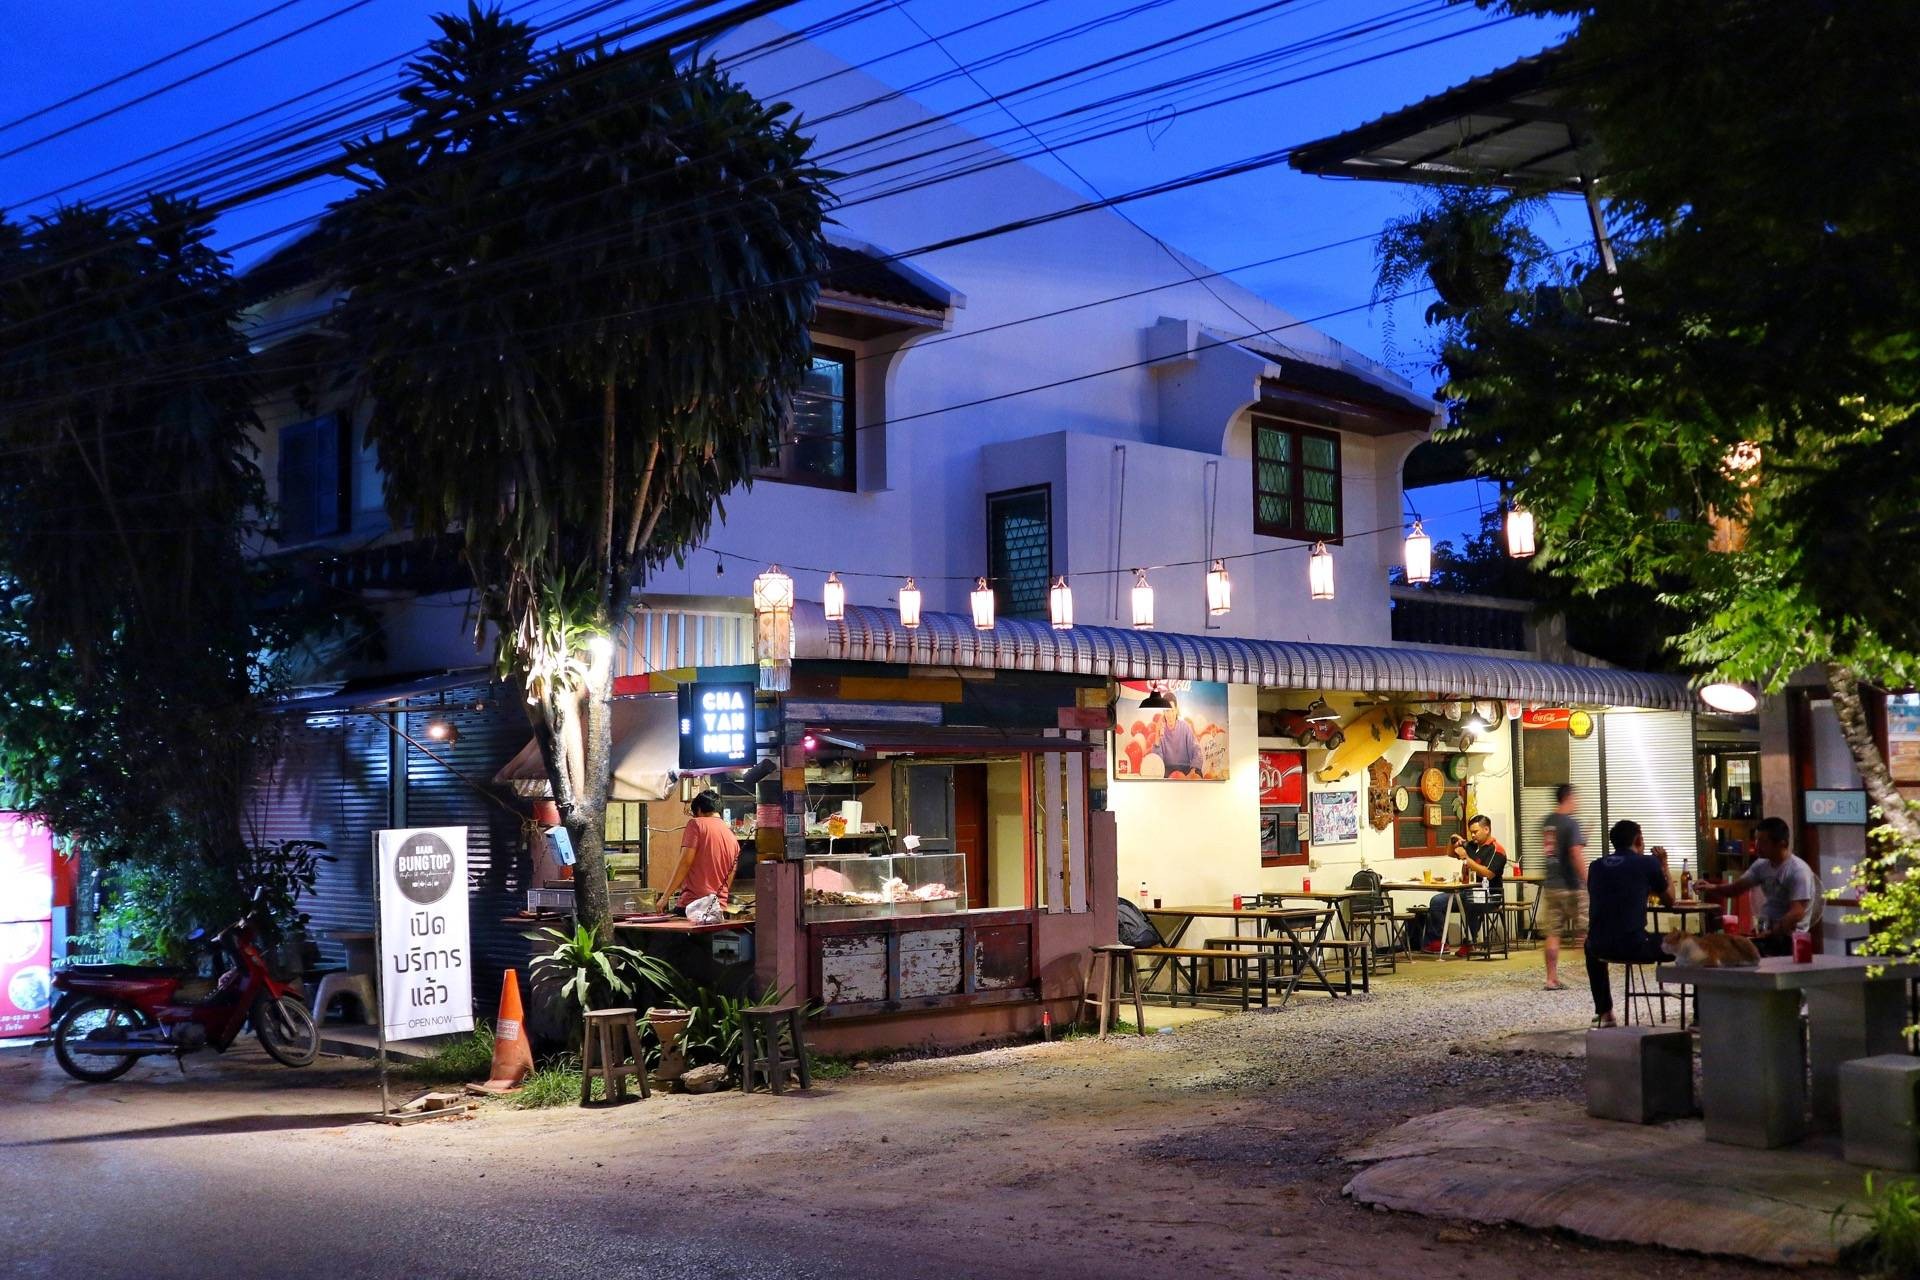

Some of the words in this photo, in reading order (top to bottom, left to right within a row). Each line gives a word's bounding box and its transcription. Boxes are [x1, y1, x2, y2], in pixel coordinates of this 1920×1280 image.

[703, 692, 744, 710] CHA
[1812, 800, 1858, 814] OPEN
[411, 911, 445, 936] เปิด
[393, 947, 462, 973] บริการ
[411, 977, 448, 1006] แล้ว
[408, 1018, 430, 1028] OPEN
[431, 1015, 452, 1025] NOW
